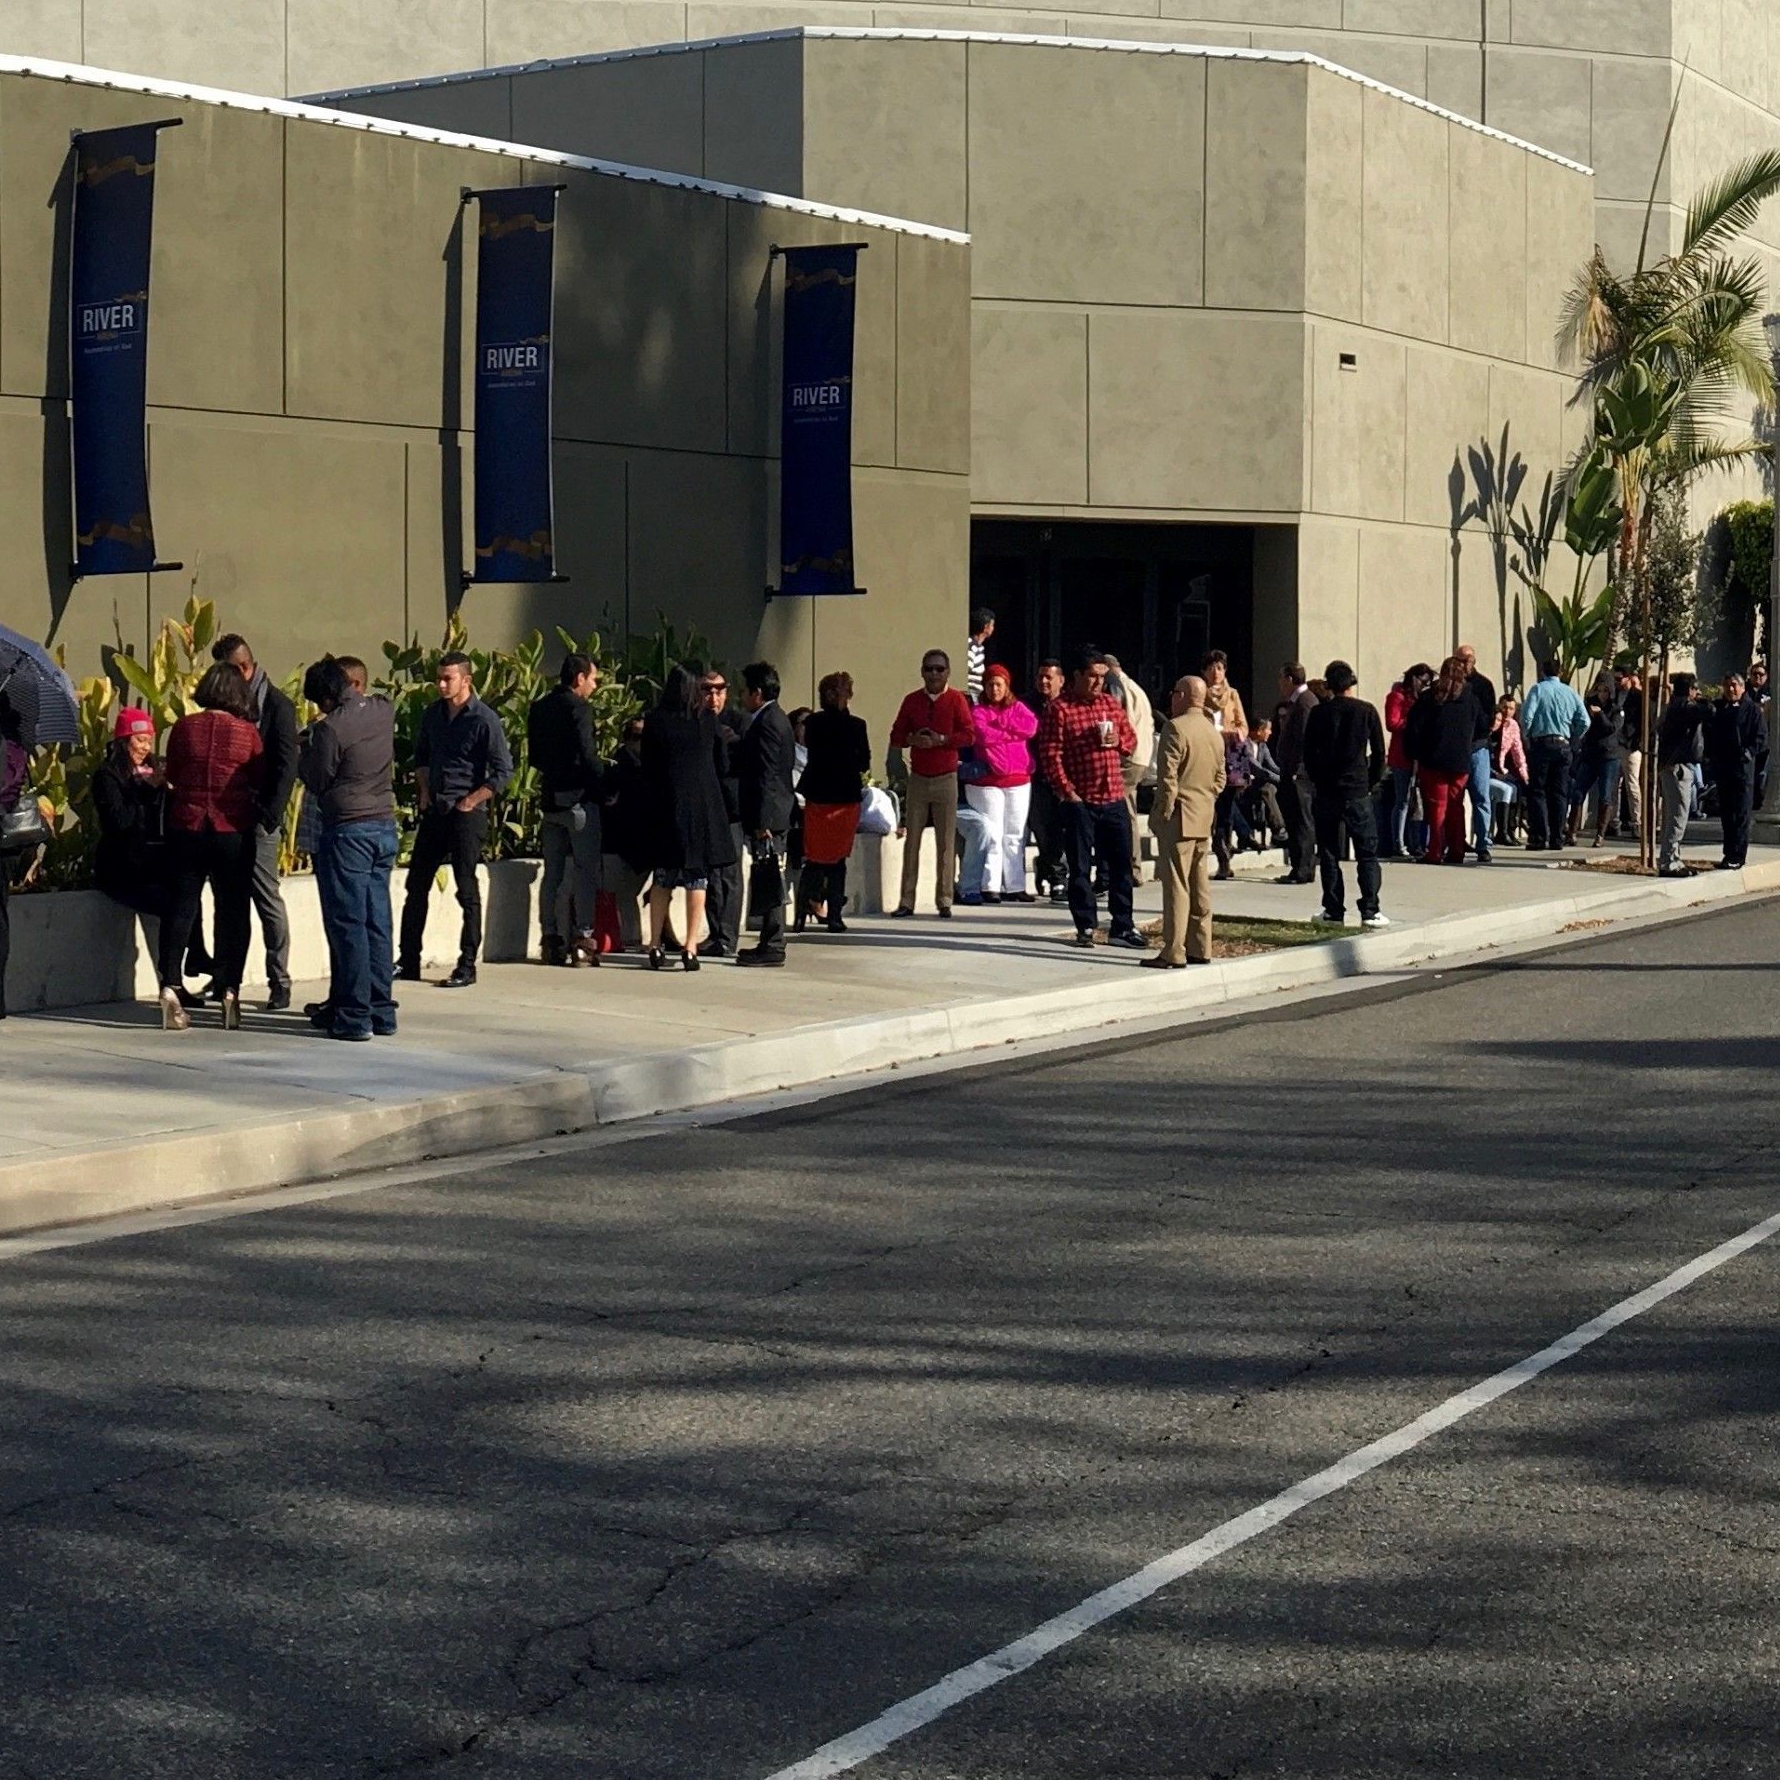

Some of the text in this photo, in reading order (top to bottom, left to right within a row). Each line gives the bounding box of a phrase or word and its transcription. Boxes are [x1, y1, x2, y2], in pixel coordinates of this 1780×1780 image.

[83, 305, 133, 332] RIVER
[487, 347, 537, 369] RIVER
[793, 386, 840, 406] RIVER
